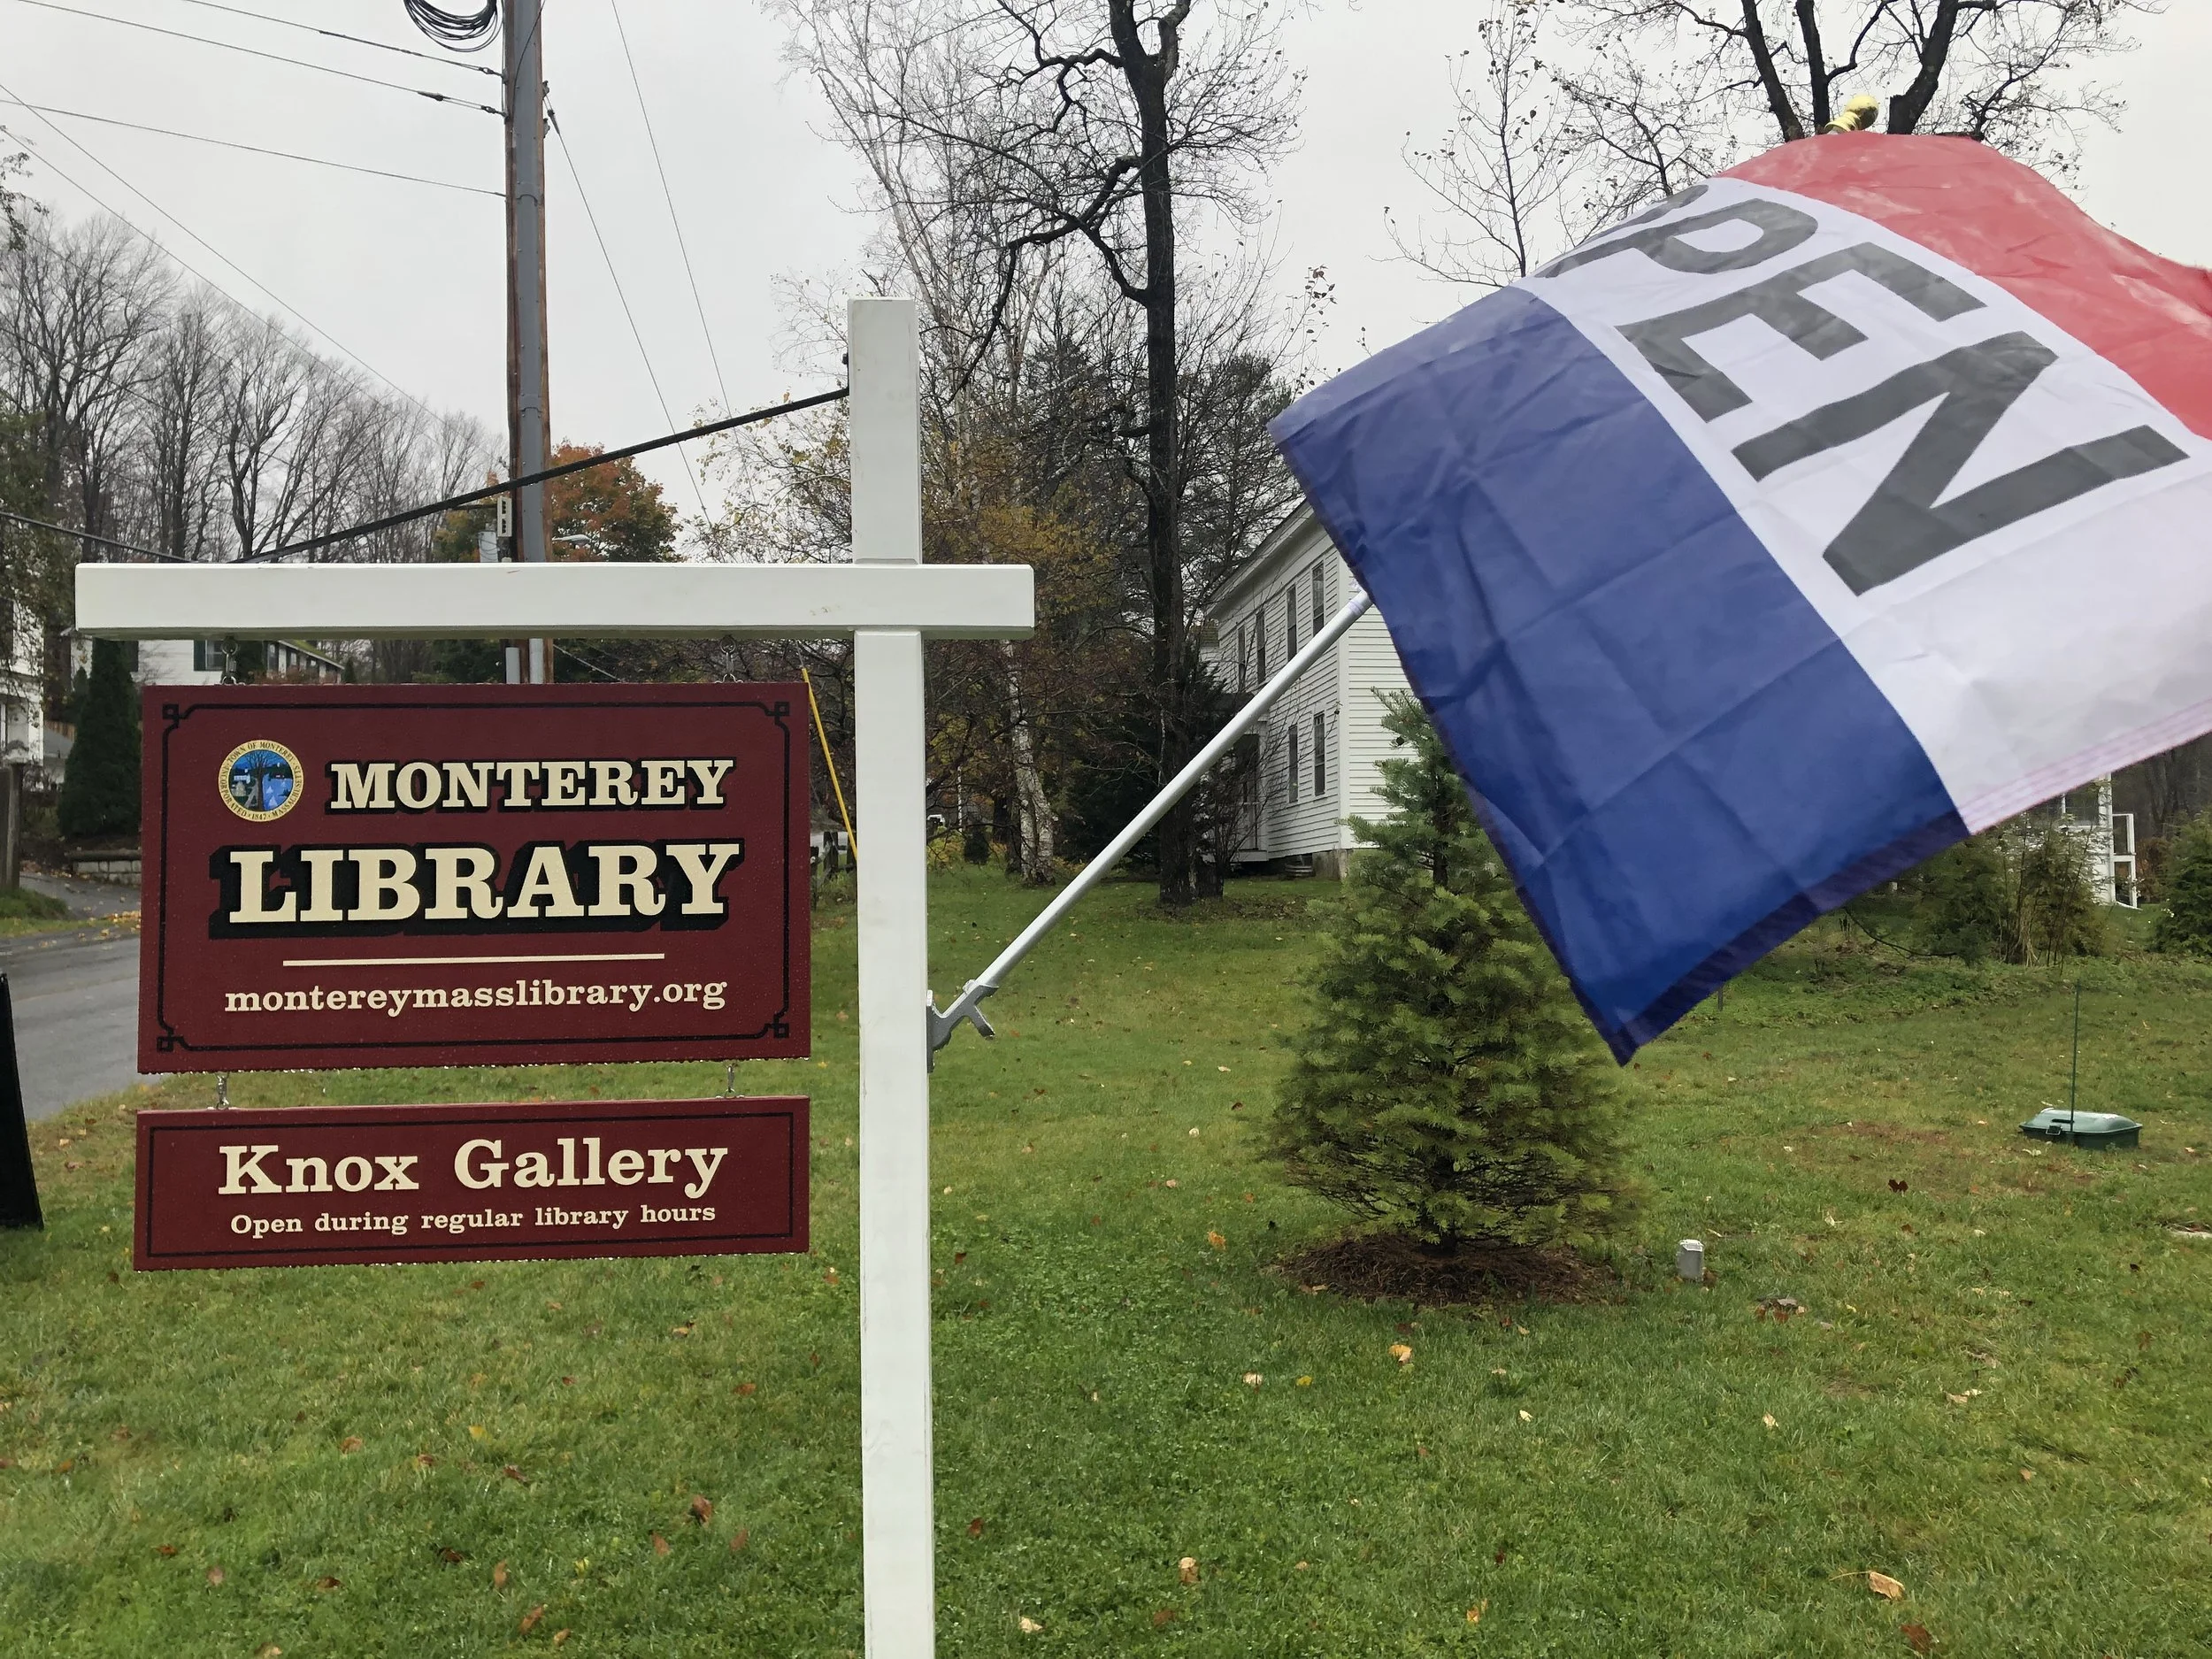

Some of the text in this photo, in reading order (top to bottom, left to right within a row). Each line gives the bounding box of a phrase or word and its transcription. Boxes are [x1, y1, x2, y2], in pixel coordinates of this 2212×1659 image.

[1532, 184, 2191, 596] PEN
[227, 745, 247, 763] TOWN
[259, 741, 295, 762] MONTEREY
[330, 759, 733, 809] MONTEREY
[229, 843, 740, 924] LIBRARY
[224, 979, 728, 1018] montereymasslibrary.org
[218, 1137, 728, 1199] Knox Gallery
[230, 1204, 716, 1240] Open during regular library hours
